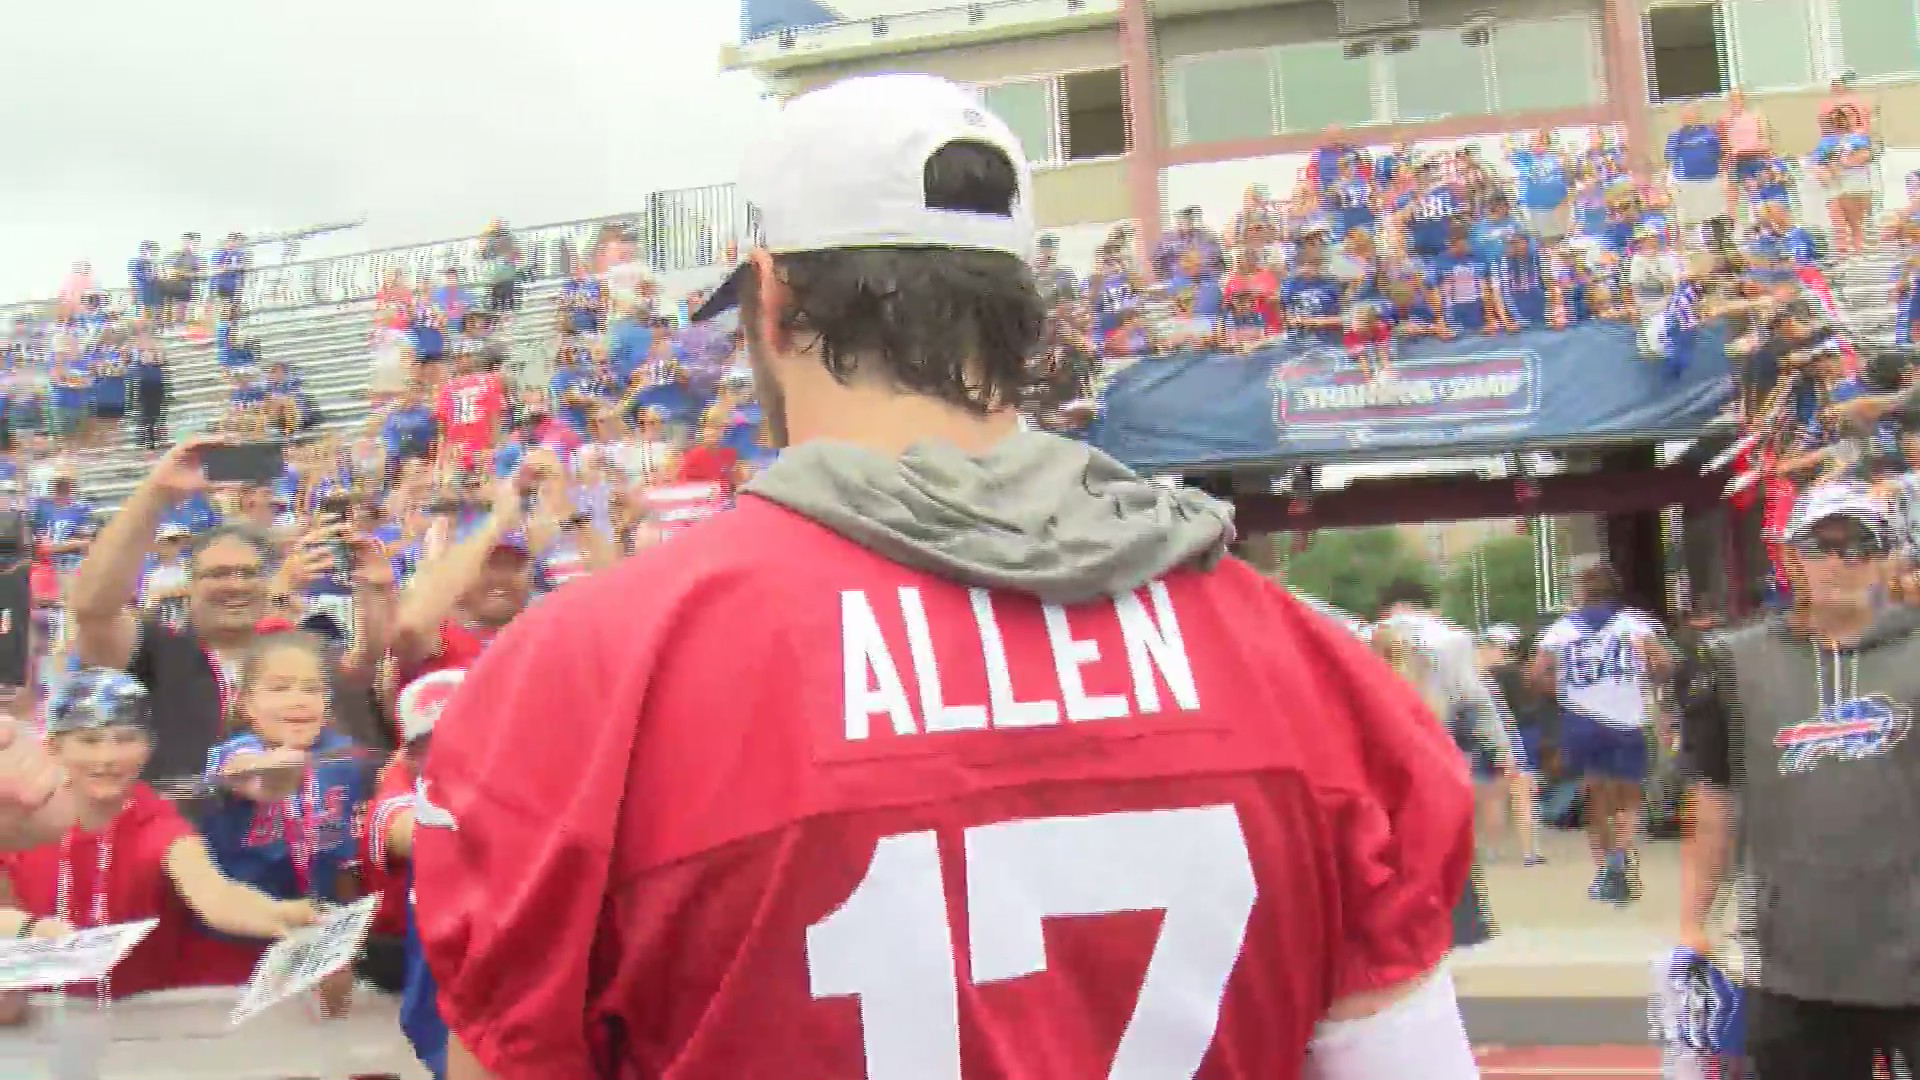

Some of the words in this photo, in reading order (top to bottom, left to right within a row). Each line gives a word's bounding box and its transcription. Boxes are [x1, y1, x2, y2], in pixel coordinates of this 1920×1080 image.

[840, 581, 1200, 740] ALLEN
[1565, 634, 1636, 689] 64
[806, 803, 1258, 1080] 17
